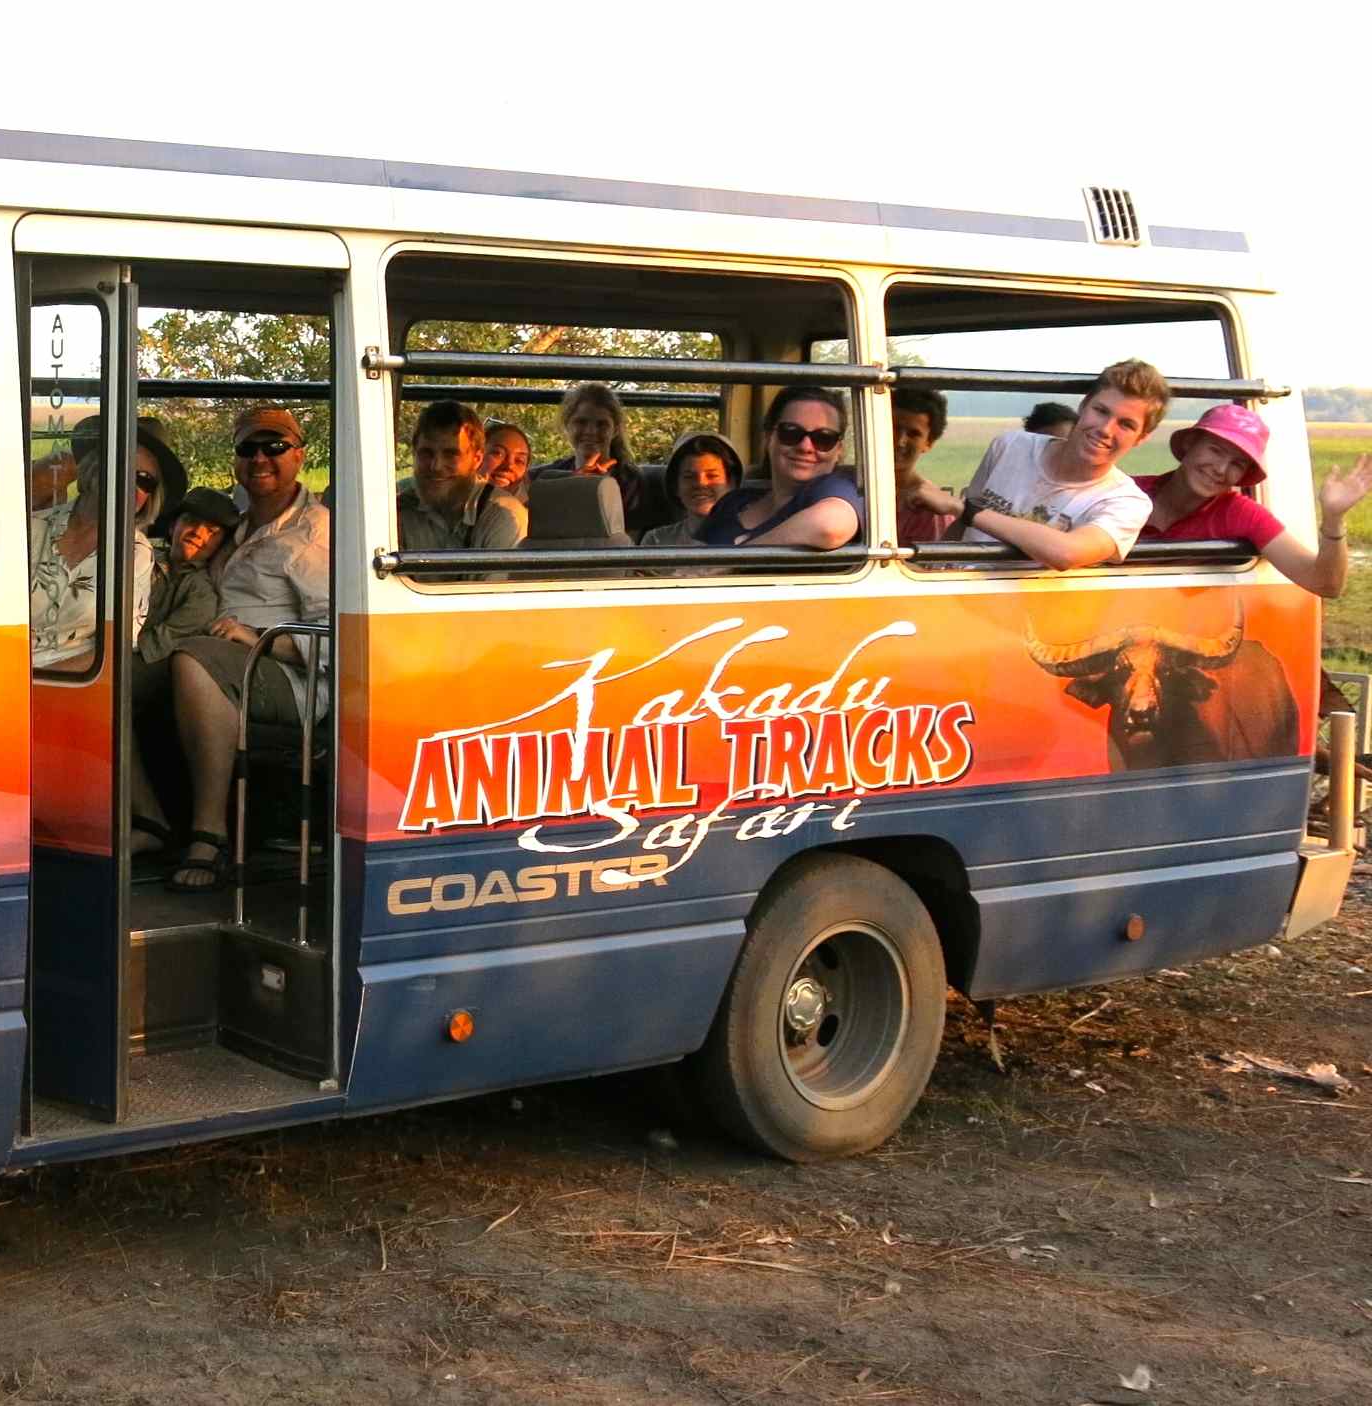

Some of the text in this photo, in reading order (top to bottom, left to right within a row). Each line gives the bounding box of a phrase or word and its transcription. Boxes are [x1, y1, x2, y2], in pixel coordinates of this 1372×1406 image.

[431, 618, 917, 781] Kakadu
[397, 701, 976, 831] ANIMAL TRACKS
[387, 854, 670, 915] COASTER
[517, 783, 861, 885] Safari
